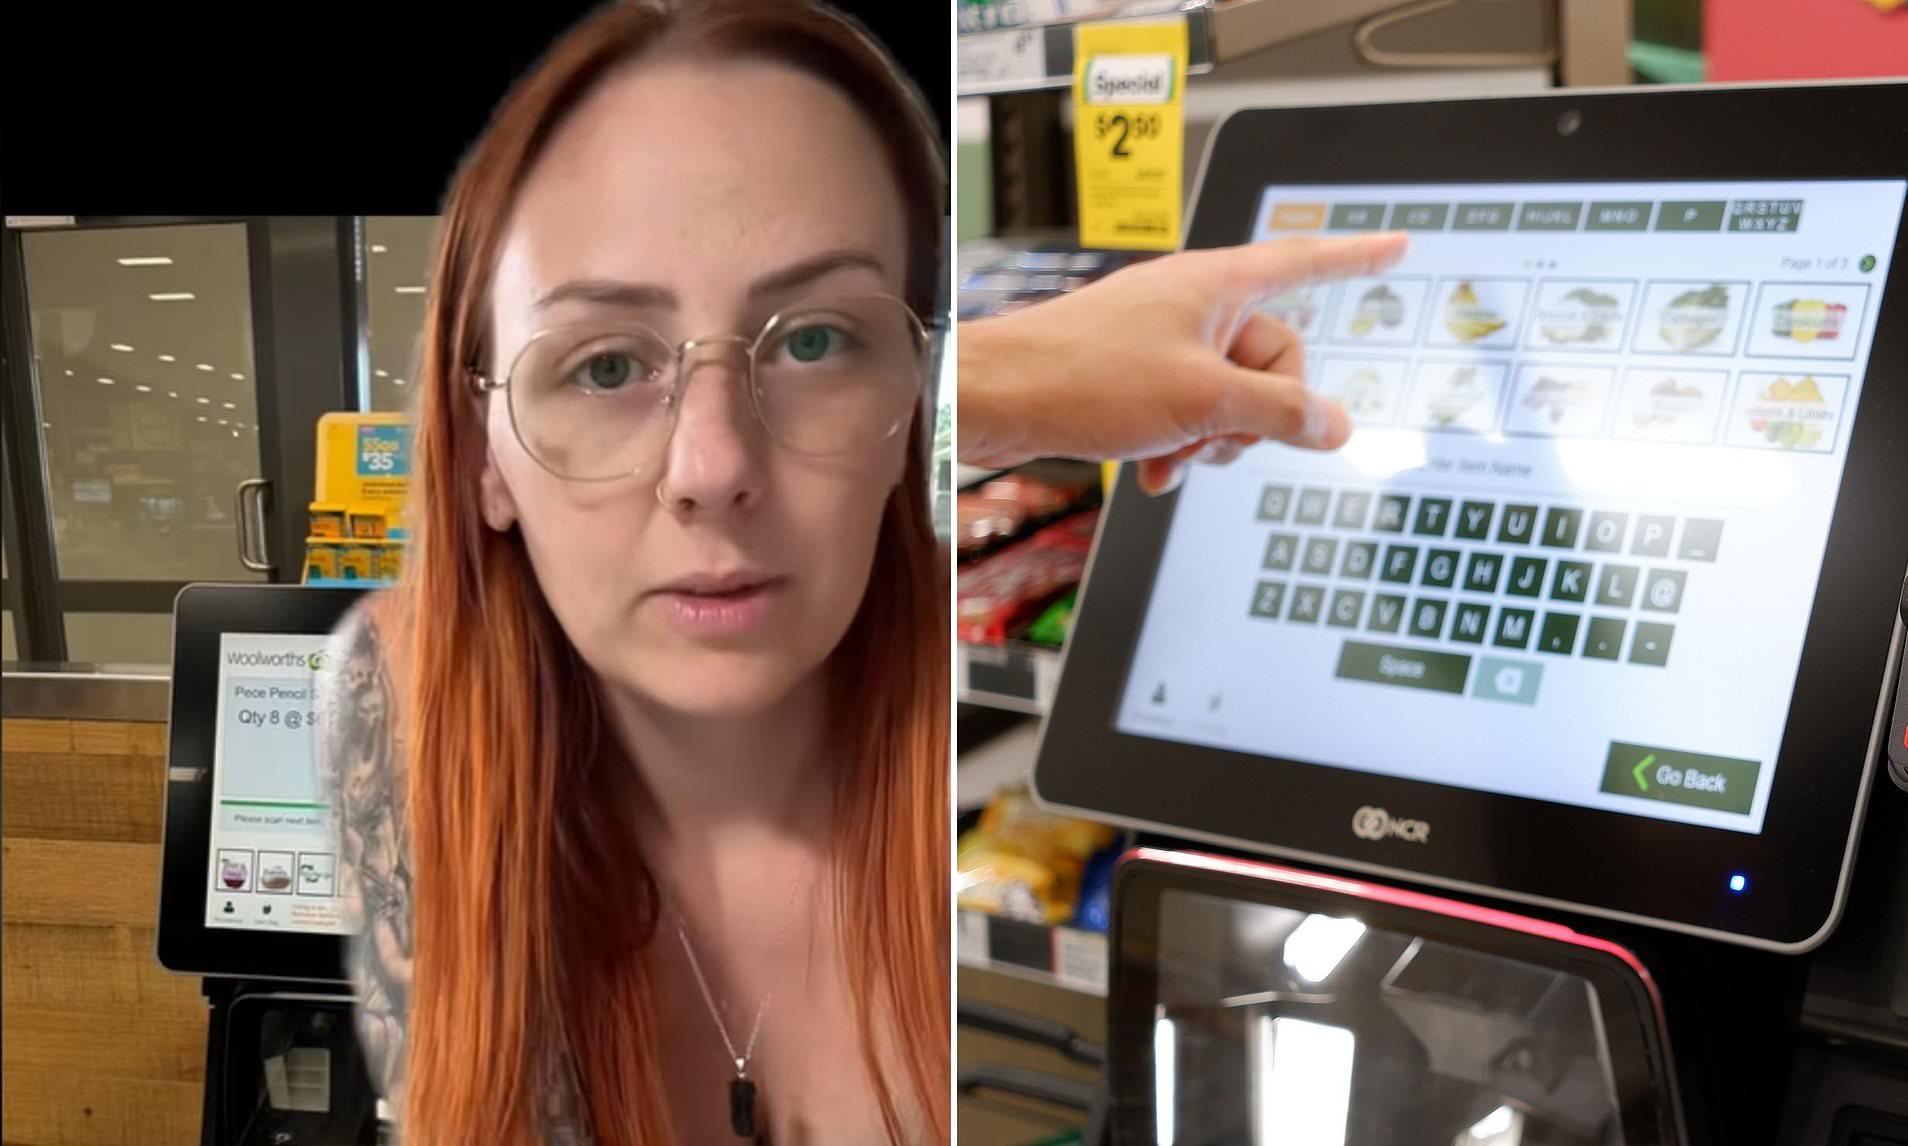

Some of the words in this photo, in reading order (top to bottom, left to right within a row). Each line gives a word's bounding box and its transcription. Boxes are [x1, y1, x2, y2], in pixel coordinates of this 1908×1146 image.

[1425, 503, 1444, 529] T
[1466, 506, 1486, 532] Y
[1507, 510, 1530, 537] U
[1555, 514, 1569, 540] I
[1596, 518, 1617, 544] O
[1642, 522, 1664, 548] P
[1272, 539, 1290, 565] A
[1390, 550, 1411, 576] F
[1472, 559, 1495, 585] H
[1517, 563, 1537, 589] J
[1560, 566, 1584, 594] K
[1607, 572, 1623, 598] L
[1650, 577, 1678, 608] @
[1258, 585, 1279, 612] Z
[1296, 590, 1315, 617] X
[1378, 600, 1399, 625] V
[1460, 608, 1482, 636] N
[1501, 614, 1527, 641] M
[1377, 653, 1426, 679] Space
[238, 709, 267, 728] Qty
[270, 709, 280, 725] 8
[284, 710, 303, 730] @
[1655, 764, 1683, 787] Go
[1683, 767, 1728, 794] Back
[1386, 817, 1431, 844] NCR
